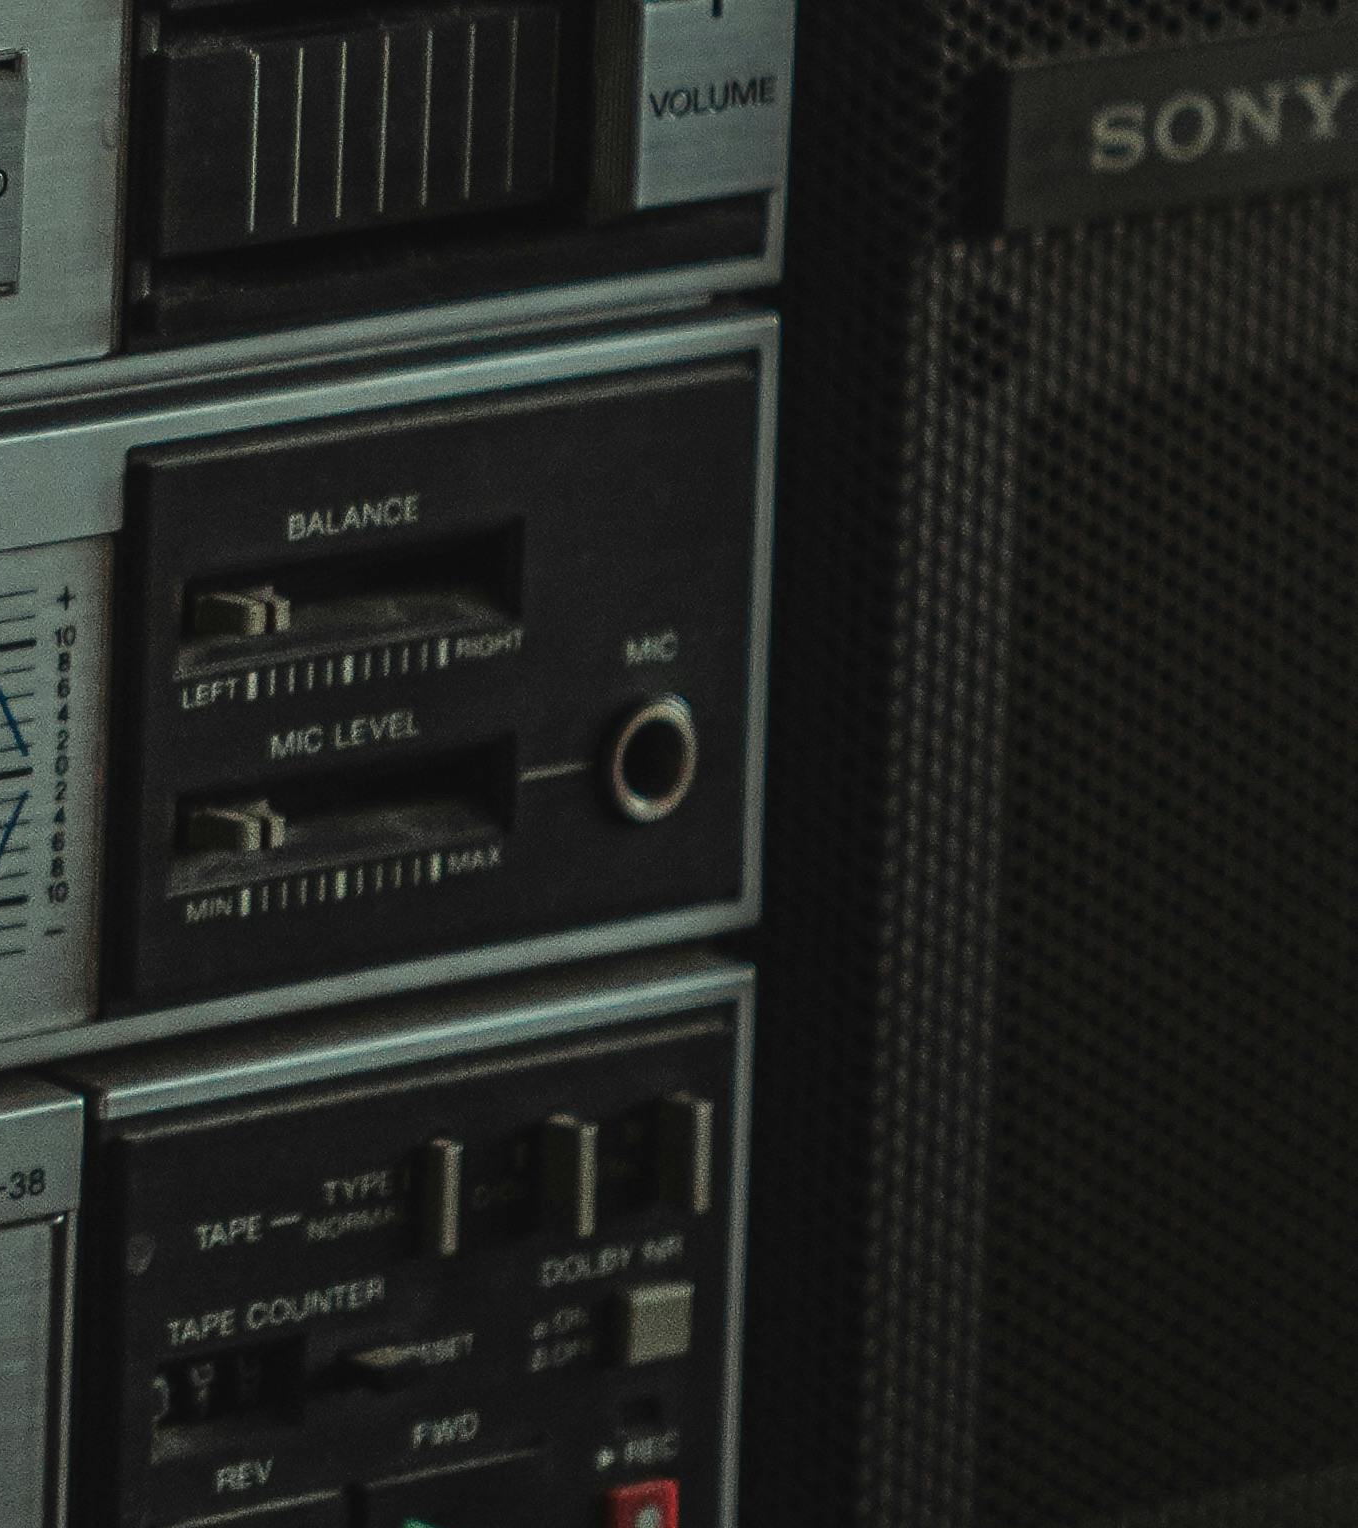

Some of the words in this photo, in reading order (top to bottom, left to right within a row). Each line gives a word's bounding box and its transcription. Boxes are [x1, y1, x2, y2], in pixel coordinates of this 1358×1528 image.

[649, 77, 775, 118] VOLUME
[1090, 71, 1358, 174] SONY
[287, 493, 420, 541] BALANCE
[624, 631, 679, 664] MIC
[183, 677, 240, 709] LEFT
[455, 629, 524, 661] RIGHT
[271, 727, 323, 760] MIC
[335, 710, 419, 748] LEVEL
[187, 896, 233, 924] MIN
[323, 1169, 389, 1205] TYPE
[195, 1213, 263, 1251] TAPE
[537, 1247, 632, 1289] DOLBY
[167, 1308, 236, 1345] TAPE
[246, 1274, 385, 1331] COUNTER
[409, 1408, 479, 1451] FWD
[214, 1456, 275, 1493] REV
